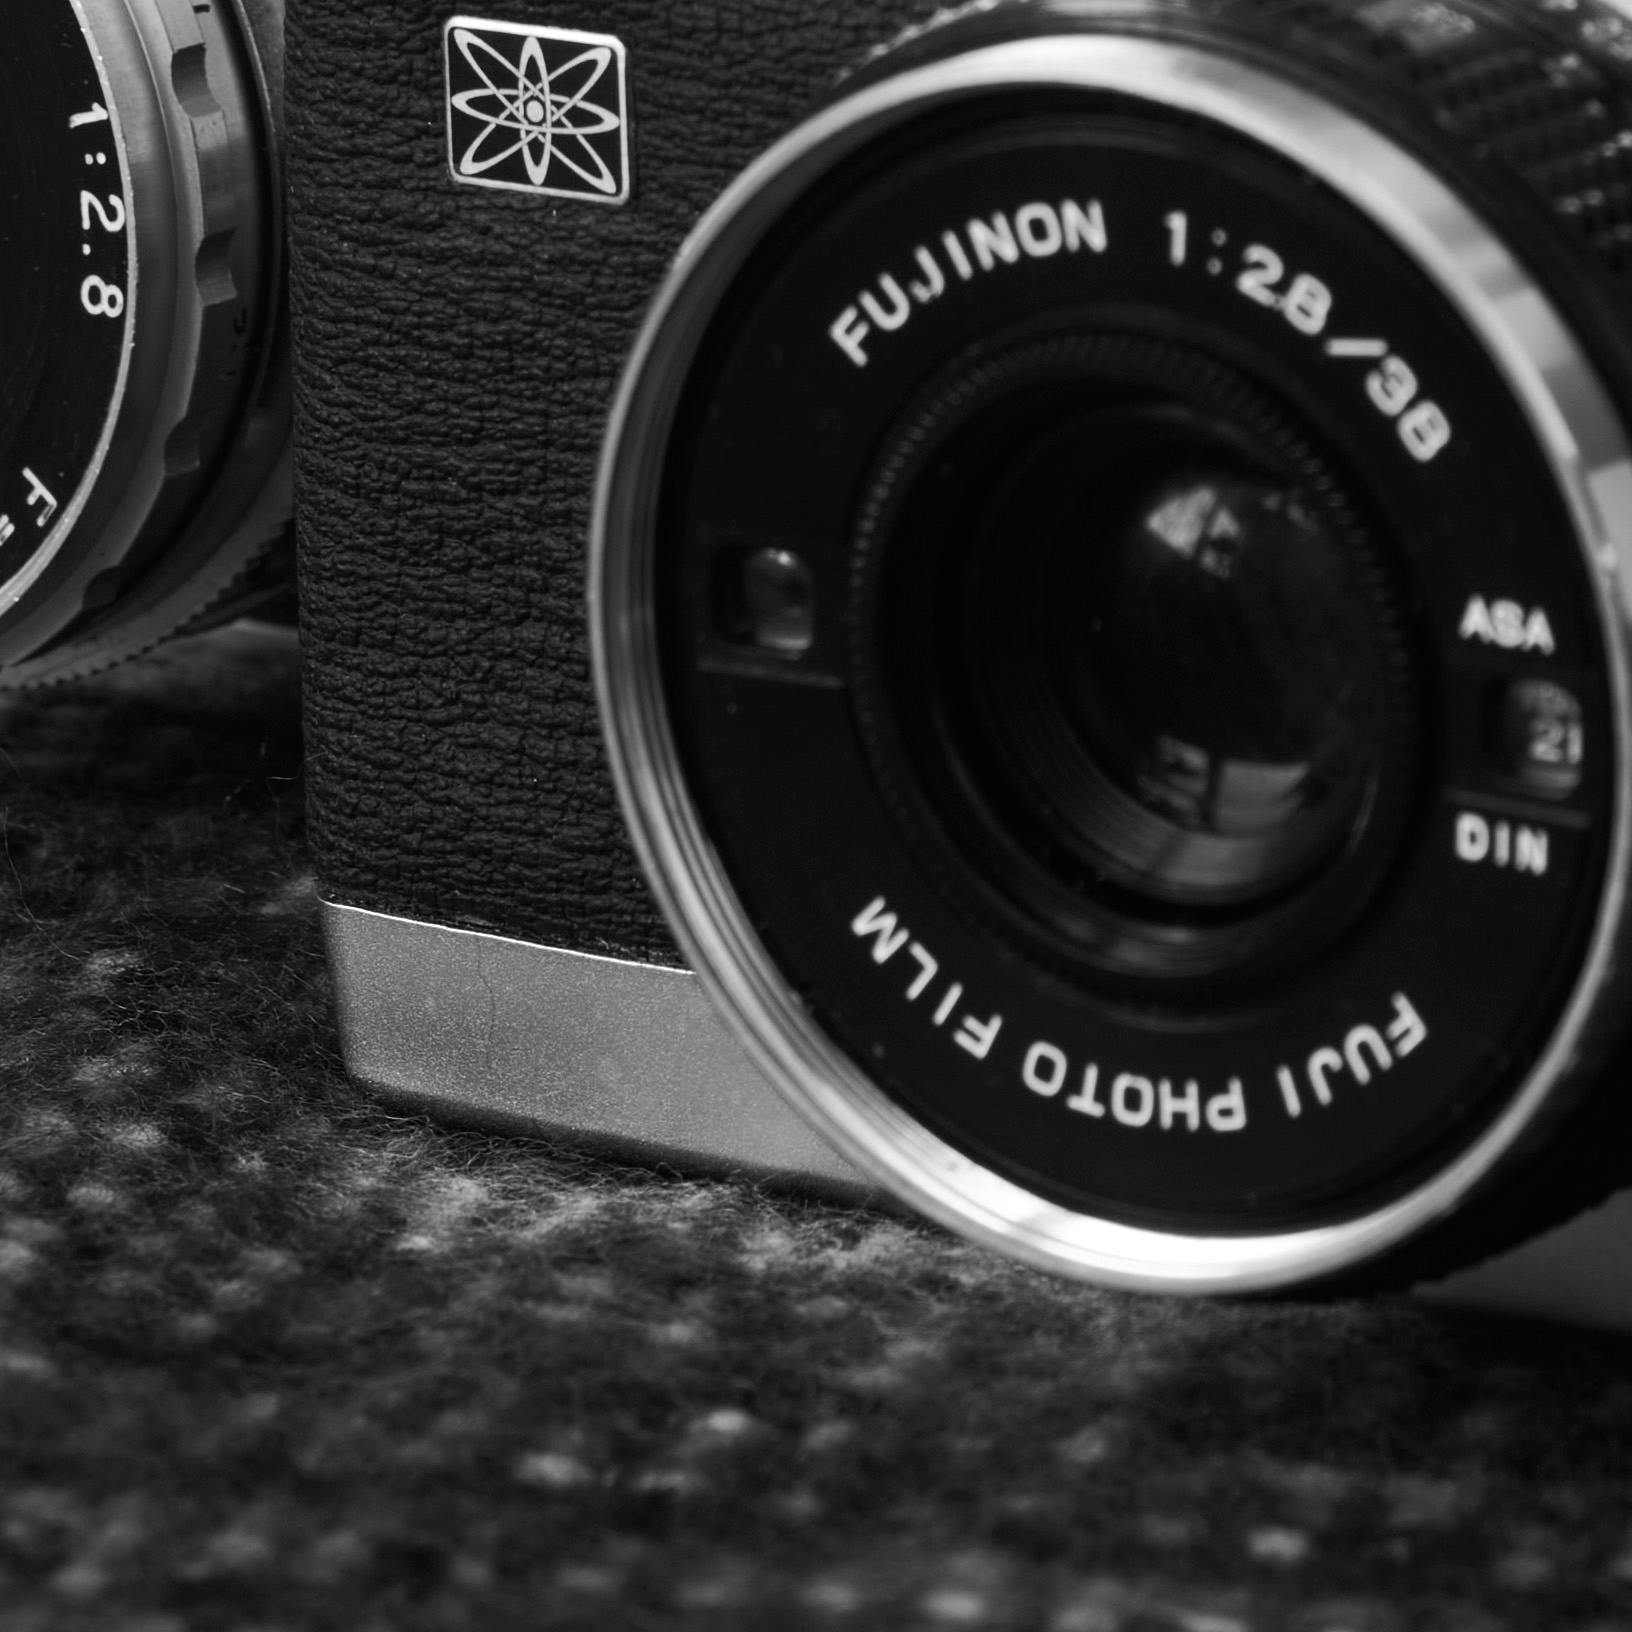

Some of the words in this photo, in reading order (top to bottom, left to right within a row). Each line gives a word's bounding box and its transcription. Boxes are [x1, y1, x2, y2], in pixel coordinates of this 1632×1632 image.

[68, 101, 126, 319] 1:2.8
[829, 198, 1109, 368] FUJINON
[1458, 595, 1556, 656] ASA
[1454, 810, 1551, 877] DIN
[850, 896, 1005, 1061] FILM
[1021, 1040, 1249, 1134] PHOTO
[1276, 992, 1429, 1118] FUJI
